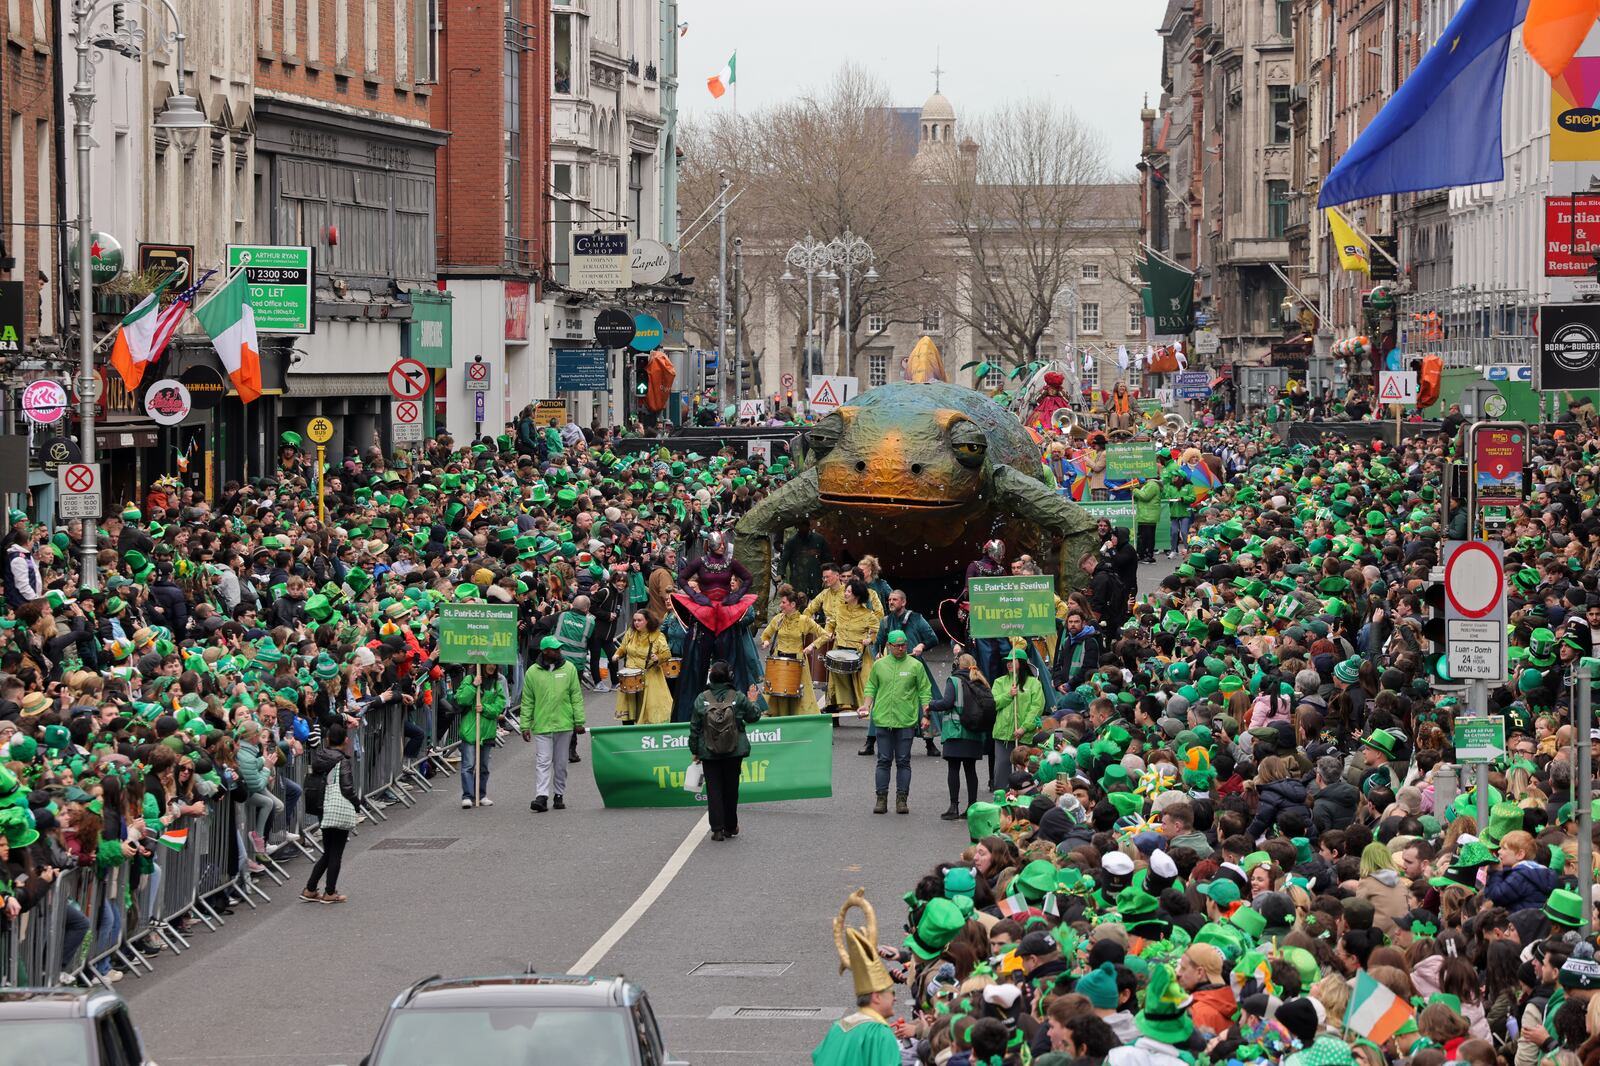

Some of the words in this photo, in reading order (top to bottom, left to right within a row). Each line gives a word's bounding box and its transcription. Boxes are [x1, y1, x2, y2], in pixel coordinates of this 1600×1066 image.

[1564, 115, 1600, 128] sn@p
[1576, 229, 1587, 239] &
[577, 238, 624, 250] COMPANY
[258, 270, 280, 278] 2300
[282, 271, 299, 279] 300
[250, 288, 264, 297] TO
[268, 288, 284, 297] LET
[636, 328, 660, 337] entra
[1405, 379, 1411, 396] L
[756, 404, 762, 414] K
[1496, 464, 1503, 474] 9
[1107, 507, 1136, 516] Festiva
[985, 582, 1019, 591] Patrick's
[1020, 581, 1049, 590] Festival
[486, 610, 513, 618] Festival
[974, 605, 1022, 620] Turas
[1028, 603, 1050, 618] Alf
[444, 630, 488, 646] Turas
[493, 631, 512, 646] Alf
[1462, 655, 1470, 663] 24
[641, 736, 659, 749] St.
